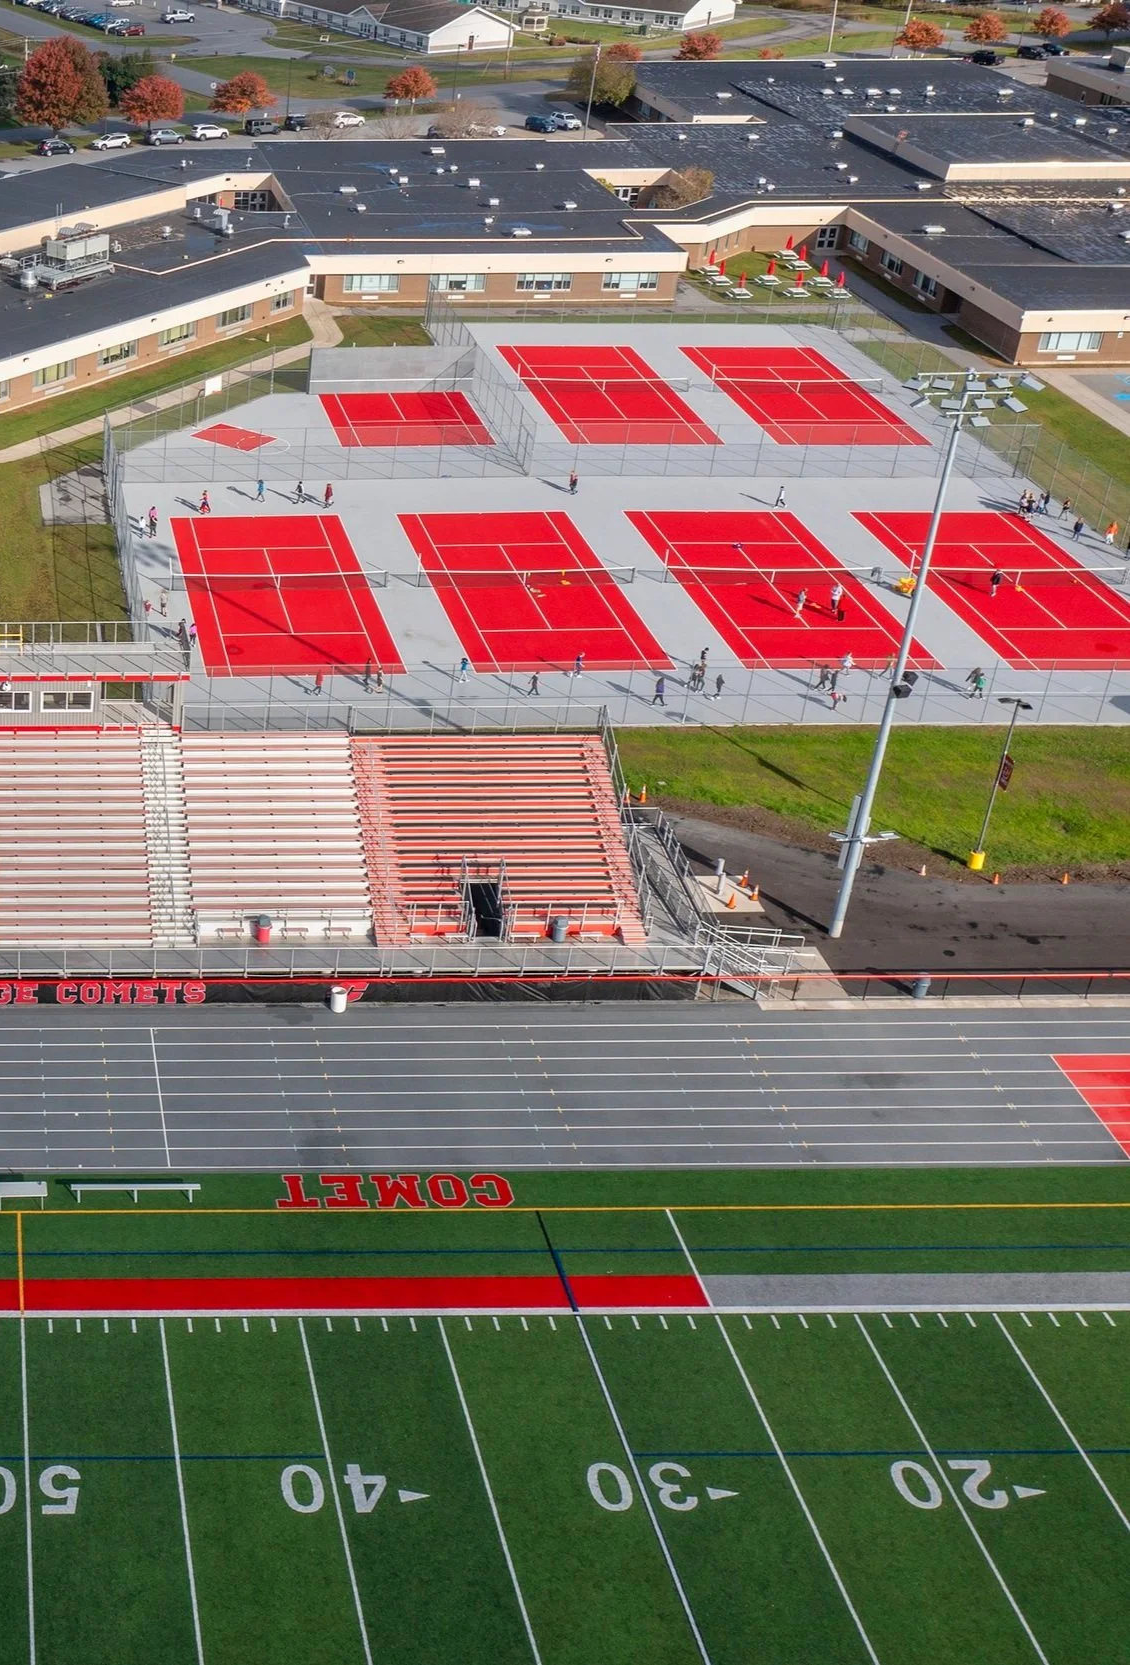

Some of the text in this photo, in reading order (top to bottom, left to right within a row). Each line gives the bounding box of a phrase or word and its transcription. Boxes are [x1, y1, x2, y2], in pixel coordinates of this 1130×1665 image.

[56, 982, 207, 1005] COMETS
[276, 1173, 515, 1208] COMET
[281, 1464, 387, 1514] 40
[586, 1462, 699, 1512] 30
[890, 1459, 1010, 1510] 20
